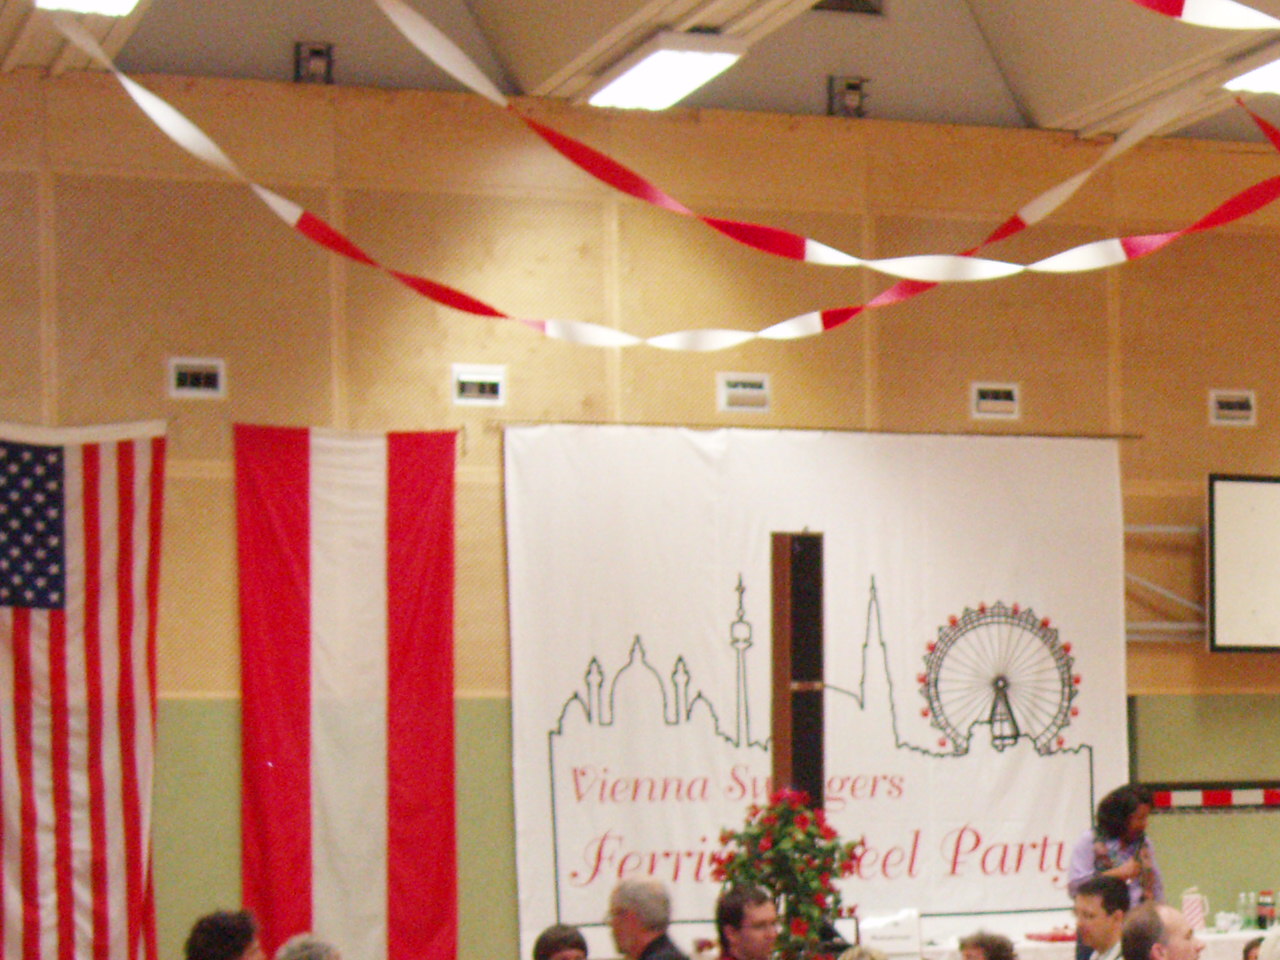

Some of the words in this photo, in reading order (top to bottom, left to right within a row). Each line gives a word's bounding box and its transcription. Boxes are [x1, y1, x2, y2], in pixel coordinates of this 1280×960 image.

[572, 764, 710, 803] Vienna
[723, 763, 906, 812] Swgers
[568, 828, 707, 888] Ferri
